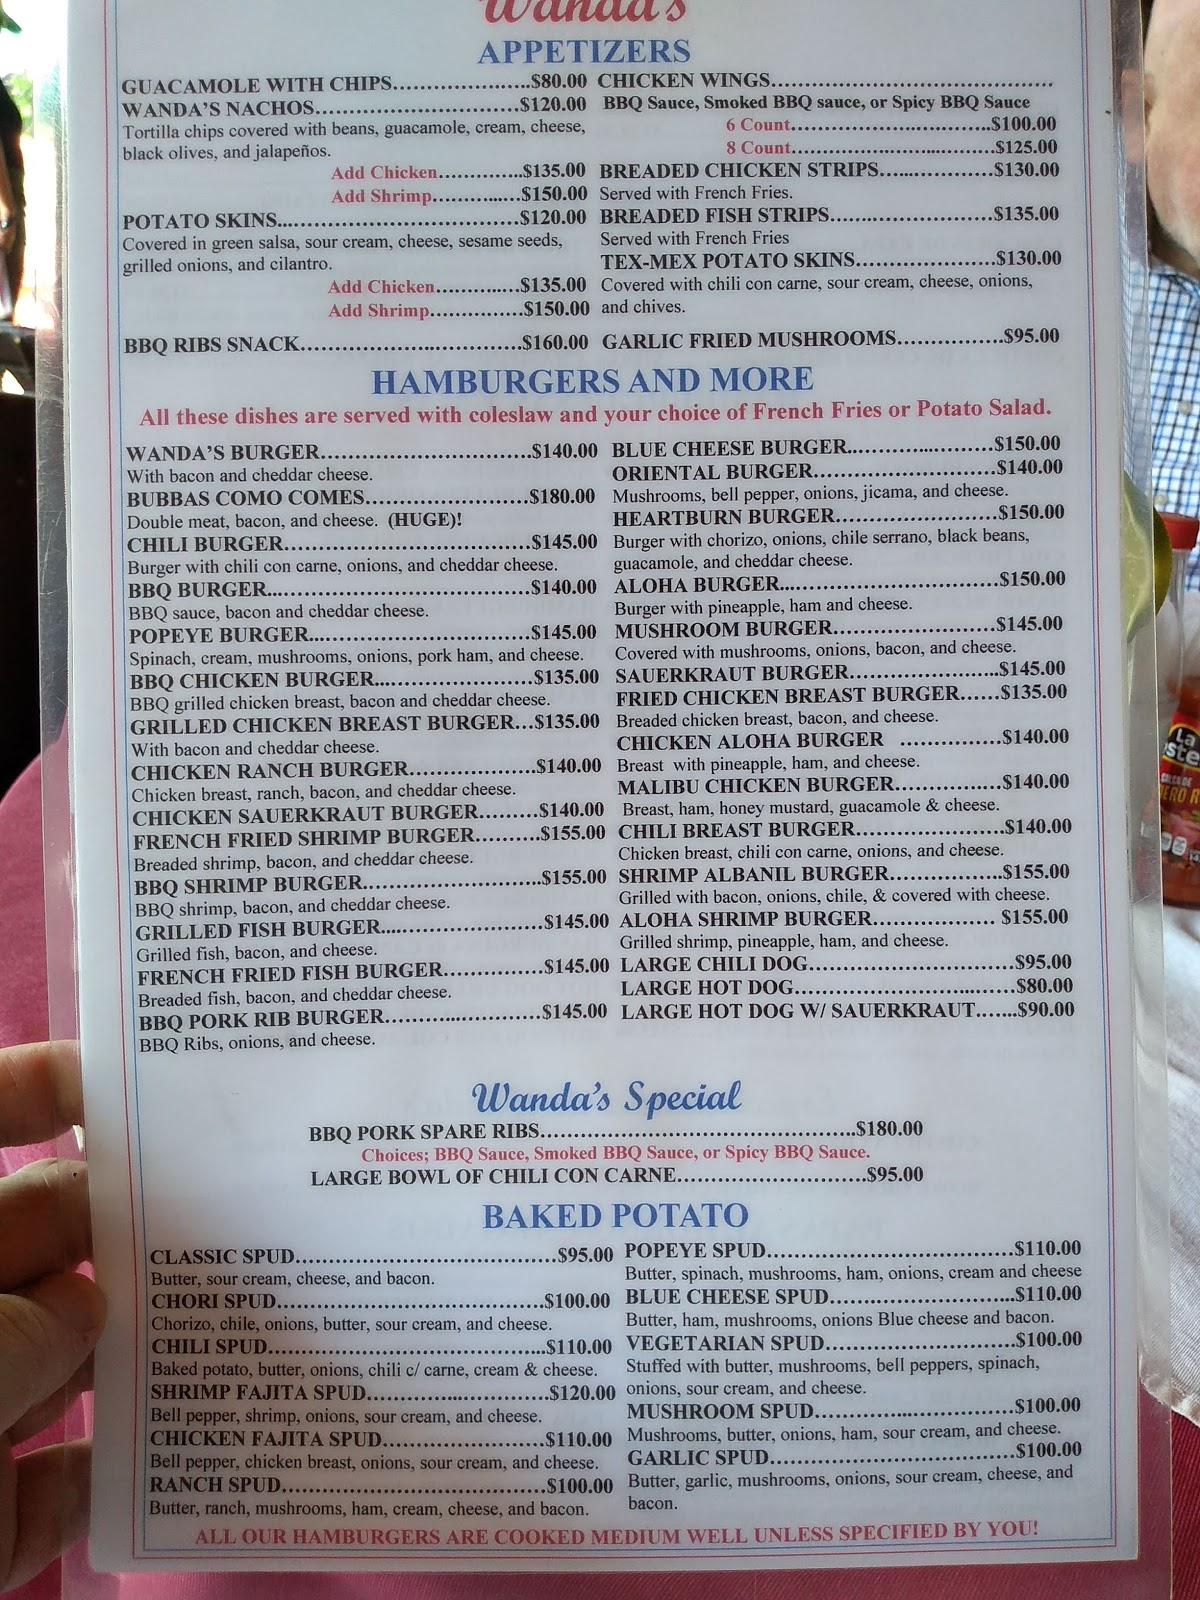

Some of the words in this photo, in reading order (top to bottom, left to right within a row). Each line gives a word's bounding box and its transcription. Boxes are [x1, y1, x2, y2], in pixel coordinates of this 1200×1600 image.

[477, 39, 691, 64] APPETIZERS
[121, 78, 261, 95] GUACAMOLE
[266, 76, 324, 93] WITH
[531, 73, 588, 90] $80.00
[597, 72, 695, 89] CHICKEN
[602, 95, 643, 113] BBQ
[647, 95, 700, 112] Sauce,
[704, 95, 768, 109] Smoked
[772, 94, 813, 112] BBQ
[817, 98, 866, 111] sauce,
[870, 98, 888, 109] or
[892, 94, 936, 112] Spicy
[939, 94, 982, 112] BBQ
[984, 94, 1031, 110] Sauce
[122, 124, 180, 139] Tortilla
[184, 123, 224, 142] chips
[229, 122, 288, 138] covered
[293, 121, 327, 136] with
[331, 121, 379, 138] beans,
[384, 119, 470, 139] guacamole,
[475, 122, 526, 136] cream,
[530, 118, 586, 135] cheese,
[122, 146, 164, 161] black
[168, 145, 218, 162] olives,
[222, 143, 251, 159] and
[253, 144, 331, 162] jalapeños.
[331, 165, 365, 180] Add
[522, 161, 586, 179] $135.00
[599, 163, 700, 179] BREADED
[704, 162, 802, 178] CHICKEN
[994, 161, 1060, 178] $130.00
[599, 185, 653, 201] Served
[656, 185, 690, 200] with
[694, 185, 747, 201] French
[750, 184, 793, 201] Fries.
[371, 368, 620, 395] HAMBURGERS
[627, 368, 700, 393] AND
[709, 366, 814, 392] MORE
[139, 408, 169, 426] All
[176, 408, 229, 425] these
[235, 406, 298, 424] dishes
[304, 411, 338, 424] are
[343, 406, 410, 424] served
[416, 405, 462, 423] with
[469, 405, 553, 423] coleslaw
[560, 405, 598, 423] and
[604, 409, 652, 427] your
[657, 403, 721, 422] choice
[726, 402, 749, 421] of
[752, 402, 824, 420] French
[831, 400, 882, 419] Fries
[888, 405, 911, 418] or
[916, 399, 983, 417] Potato
[988, 398, 1052, 416] Salad.
[611, 441, 668, 458] BLUE
[671, 440, 756, 458] CHEESE
[994, 435, 1061, 454] $150.00
[126, 468, 164, 484] With
[167, 468, 215, 483] bacon
[219, 467, 247, 483] and
[252, 466, 313, 482] cheddar
[317, 466, 373, 481] cheese.
[612, 488, 706, 505] Mushrooms,
[711, 486, 738, 502] bell
[743, 489, 799, 505] pepper,
[803, 485, 858, 502] onions,
[860, 484, 918, 503] jicama,
[922, 483, 950, 498] and
[954, 482, 1009, 497] cheese.
[129, 673, 174, 693] BBQ
[179, 672, 280, 689] CHICKEN
[534, 668, 599, 686] $135.00
[616, 734, 712, 751] CHICKEN
[717, 733, 792, 750] ALOHA
[1002, 728, 1069, 746] $140.00
[1176, 728, 1196, 748] La
[1164, 742, 1200, 765] ste
[619, 890, 672, 905] Grilled
[676, 889, 709, 904] with
[713, 889, 762, 906] bacon,
[766, 888, 821, 906] onions,
[826, 888, 867, 906] chile,
[872, 888, 887, 903] &
[892, 887, 952, 902] covered
[956, 886, 991, 901] with
[995, 886, 1050, 901] cheese.
[621, 1003, 693, 1020] LARGE
[698, 1003, 743, 1019] HOT
[748, 1003, 794, 1019] DOG
[799, 1003, 826, 1019] W/
[1017, 1001, 1075, 1018] $90.00
[139, 1037, 179, 1054] BBQ
[184, 1036, 224, 1052] Ribs,
[228, 1034, 284, 1051] onions,
[289, 1032, 316, 1048] and
[321, 1032, 375, 1047] cheese.
[472, 1081, 610, 1113] Wanda's
[624, 1080, 742, 1121] Special
[308, 1126, 352, 1145] BBQ
[357, 1124, 416, 1141] PORK
[420, 1123, 487, 1140] SPARE
[856, 1120, 923, 1137] $180.00
[361, 1148, 429, 1165] Choices;
[434, 1146, 473, 1165] BBQ
[478, 1146, 530, 1163] Sauce,
[534, 1146, 597, 1160] Smoked
[603, 1145, 642, 1163] BBQ
[647, 1145, 698, 1162] Sauce,
[703, 1148, 721, 1159] or
[725, 1144, 769, 1163] Spicy
[773, 1144, 814, 1162] BBQ
[818, 1144, 870, 1159] Sauce.
[482, 1203, 602, 1231] BAKED
[611, 1202, 749, 1228] POTATO
[149, 1248, 238, 1266] CLASSIC
[557, 1246, 614, 1264] $95.00
[150, 1271, 202, 1289] Butter,
[206, 1275, 239, 1286] sour
[242, 1275, 291, 1288] cream,
[296, 1270, 350, 1288] cheese,
[355, 1270, 382, 1285] and
[386, 1270, 435, 1285] bacon.
[625, 1266, 677, 1283] Butter,
[681, 1265, 744, 1285] spinach,
[748, 1265, 842, 1283] mushrooms,
[846, 1265, 884, 1283] ham,
[888, 1265, 944, 1282] onions,
[948, 1268, 995, 1279] cream
[999, 1263, 1028, 1280] and
[1031, 1262, 1083, 1279] cheese
[195, 1528, 237, 1545] ALL
[241, 1528, 287, 1545] OUR
[293, 1528, 440, 1545] HAMBURGERS
[446, 1529, 489, 1545] ARE
[494, 1529, 585, 1545] COOKED
[591, 1529, 680, 1545] MEDIUM
[686, 1528, 748, 1544] WELL
[754, 1526, 834, 1543] UNLESS
[839, 1523, 948, 1541] SPECIFIED
[953, 1522, 982, 1538] BY
[987, 1520, 1038, 1537] YOU!
